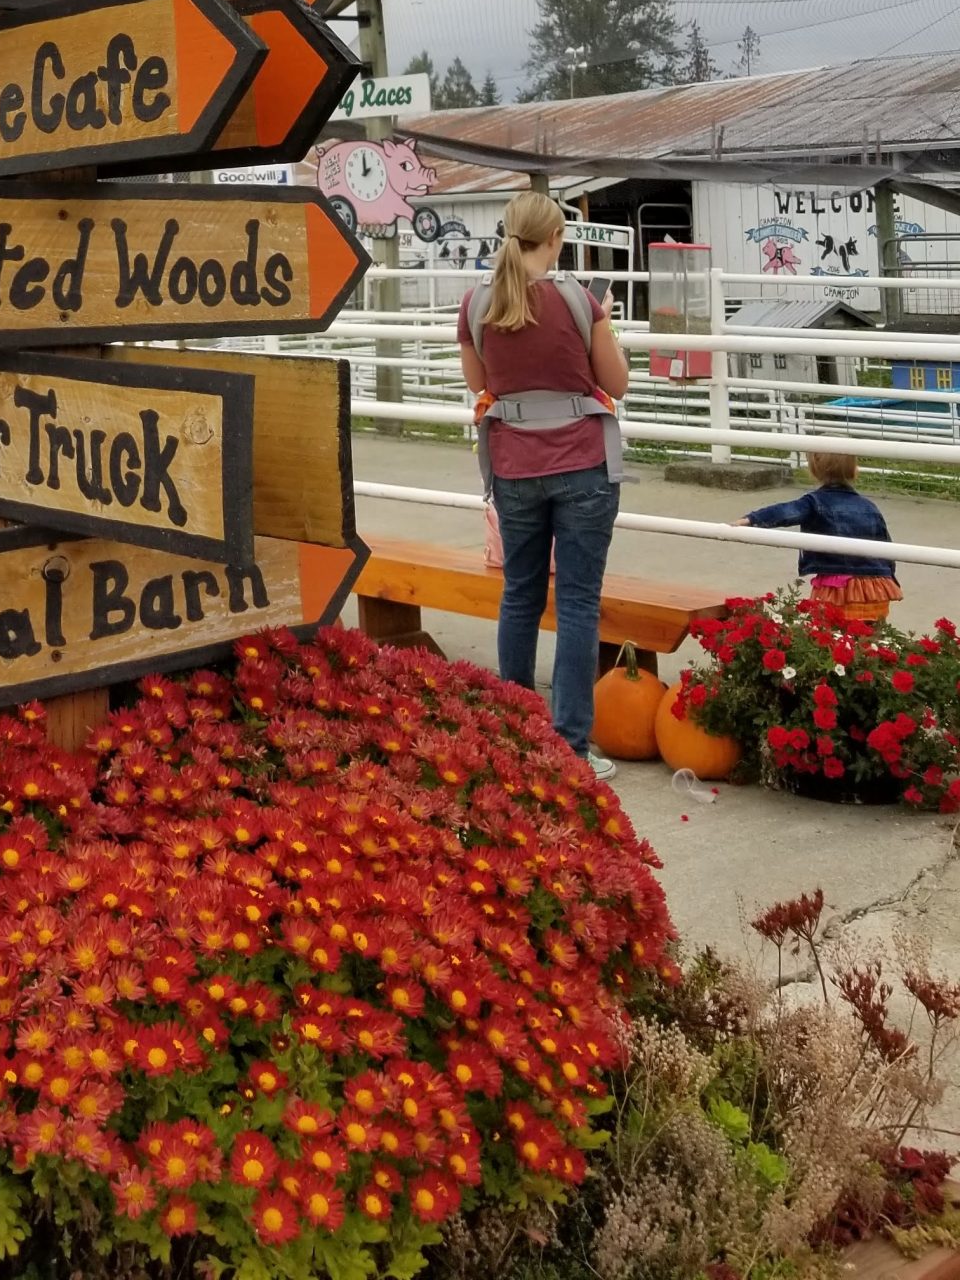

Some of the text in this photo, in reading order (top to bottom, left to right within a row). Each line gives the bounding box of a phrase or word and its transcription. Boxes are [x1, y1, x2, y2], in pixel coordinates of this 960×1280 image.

[31, 33, 172, 134] Cafe
[359, 79, 413, 108] Races
[111, 219, 295, 309] Woods
[576, 226, 614, 242] START
[14, 388, 188, 527] Truck
[90, 560, 270, 641] Barn
